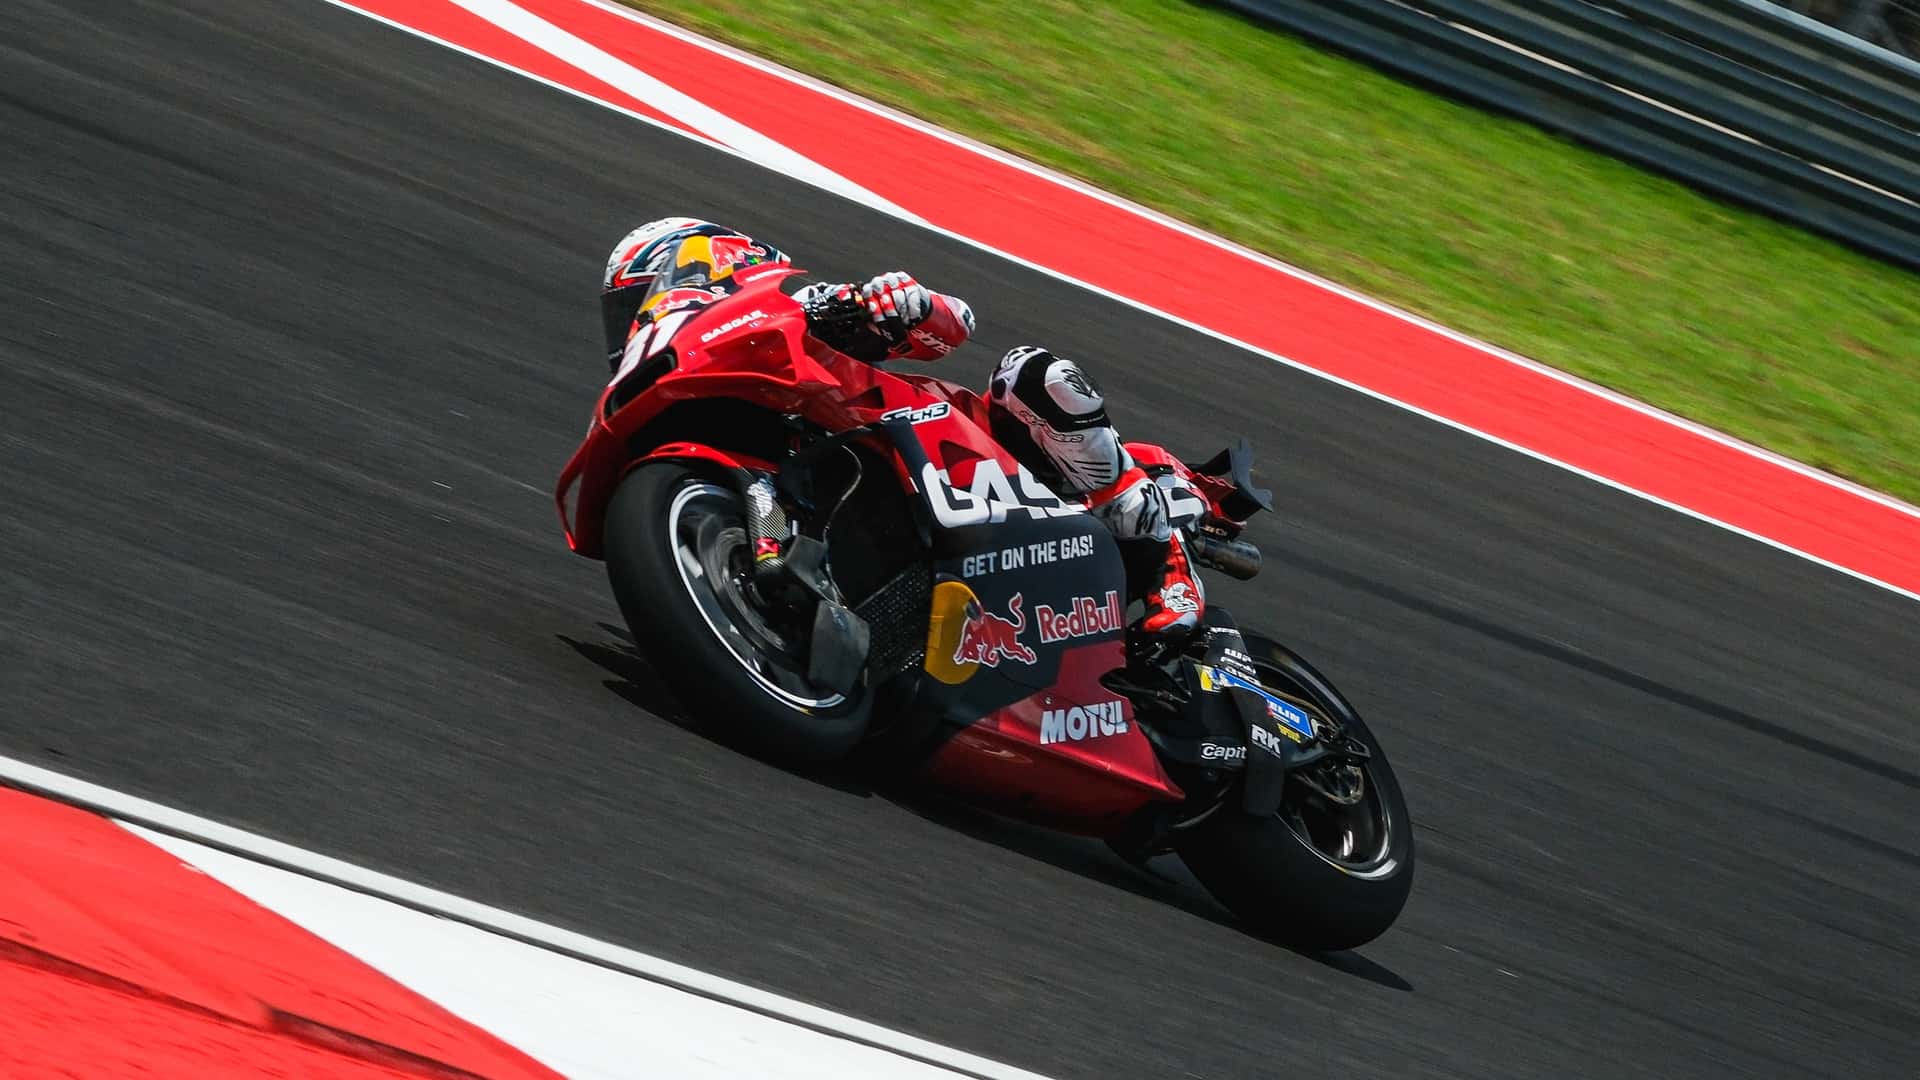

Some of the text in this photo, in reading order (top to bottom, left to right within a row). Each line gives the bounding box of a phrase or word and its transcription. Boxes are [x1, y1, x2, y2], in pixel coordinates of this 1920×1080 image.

[963, 535, 1094, 578] GET ON THE GAS!
[1039, 701, 1129, 745] MOTUL
[1252, 724, 1281, 754] RK
